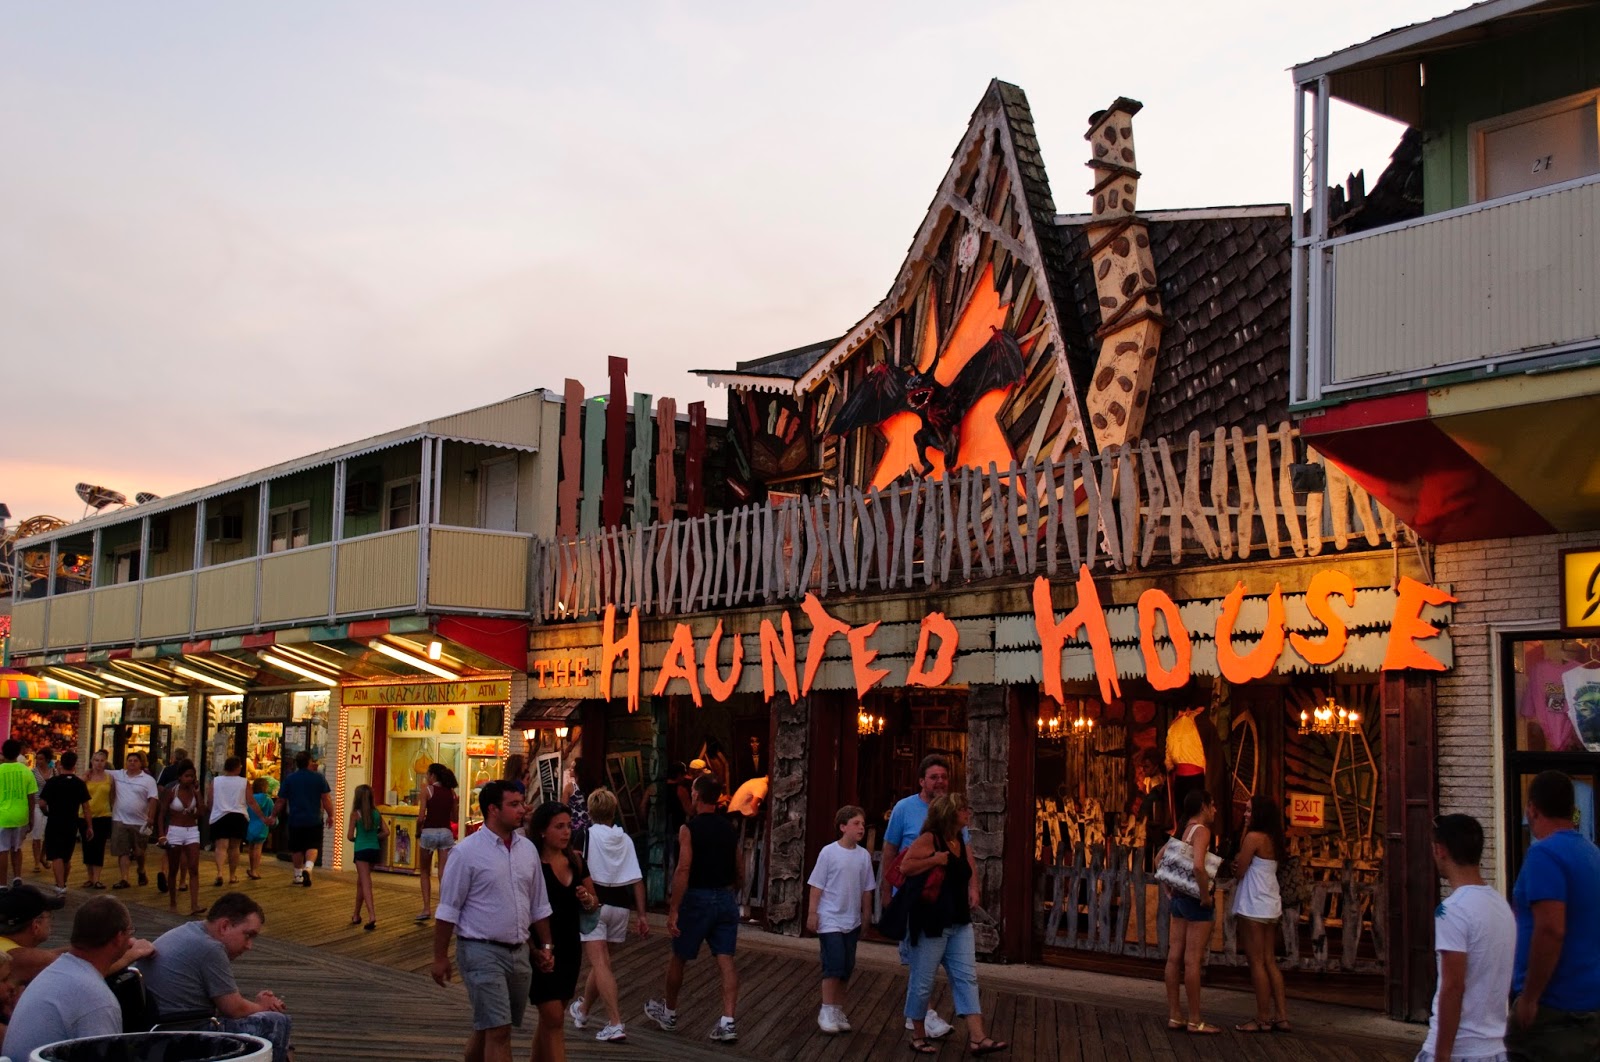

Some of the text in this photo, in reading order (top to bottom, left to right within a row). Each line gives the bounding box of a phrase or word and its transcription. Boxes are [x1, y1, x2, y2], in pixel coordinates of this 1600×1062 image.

[534, 656, 589, 688] THE
[601, 592, 959, 712] HAUNTED
[1032, 563, 1458, 704] HOUSE
[354, 690, 368, 701] ATM
[385, 685, 415, 702] CRAZY
[477, 684, 497, 697] ATM
[392, 709, 408, 732] THE
[351, 728, 362, 765] ATM
[1294, 799, 1321, 813] EXIT
